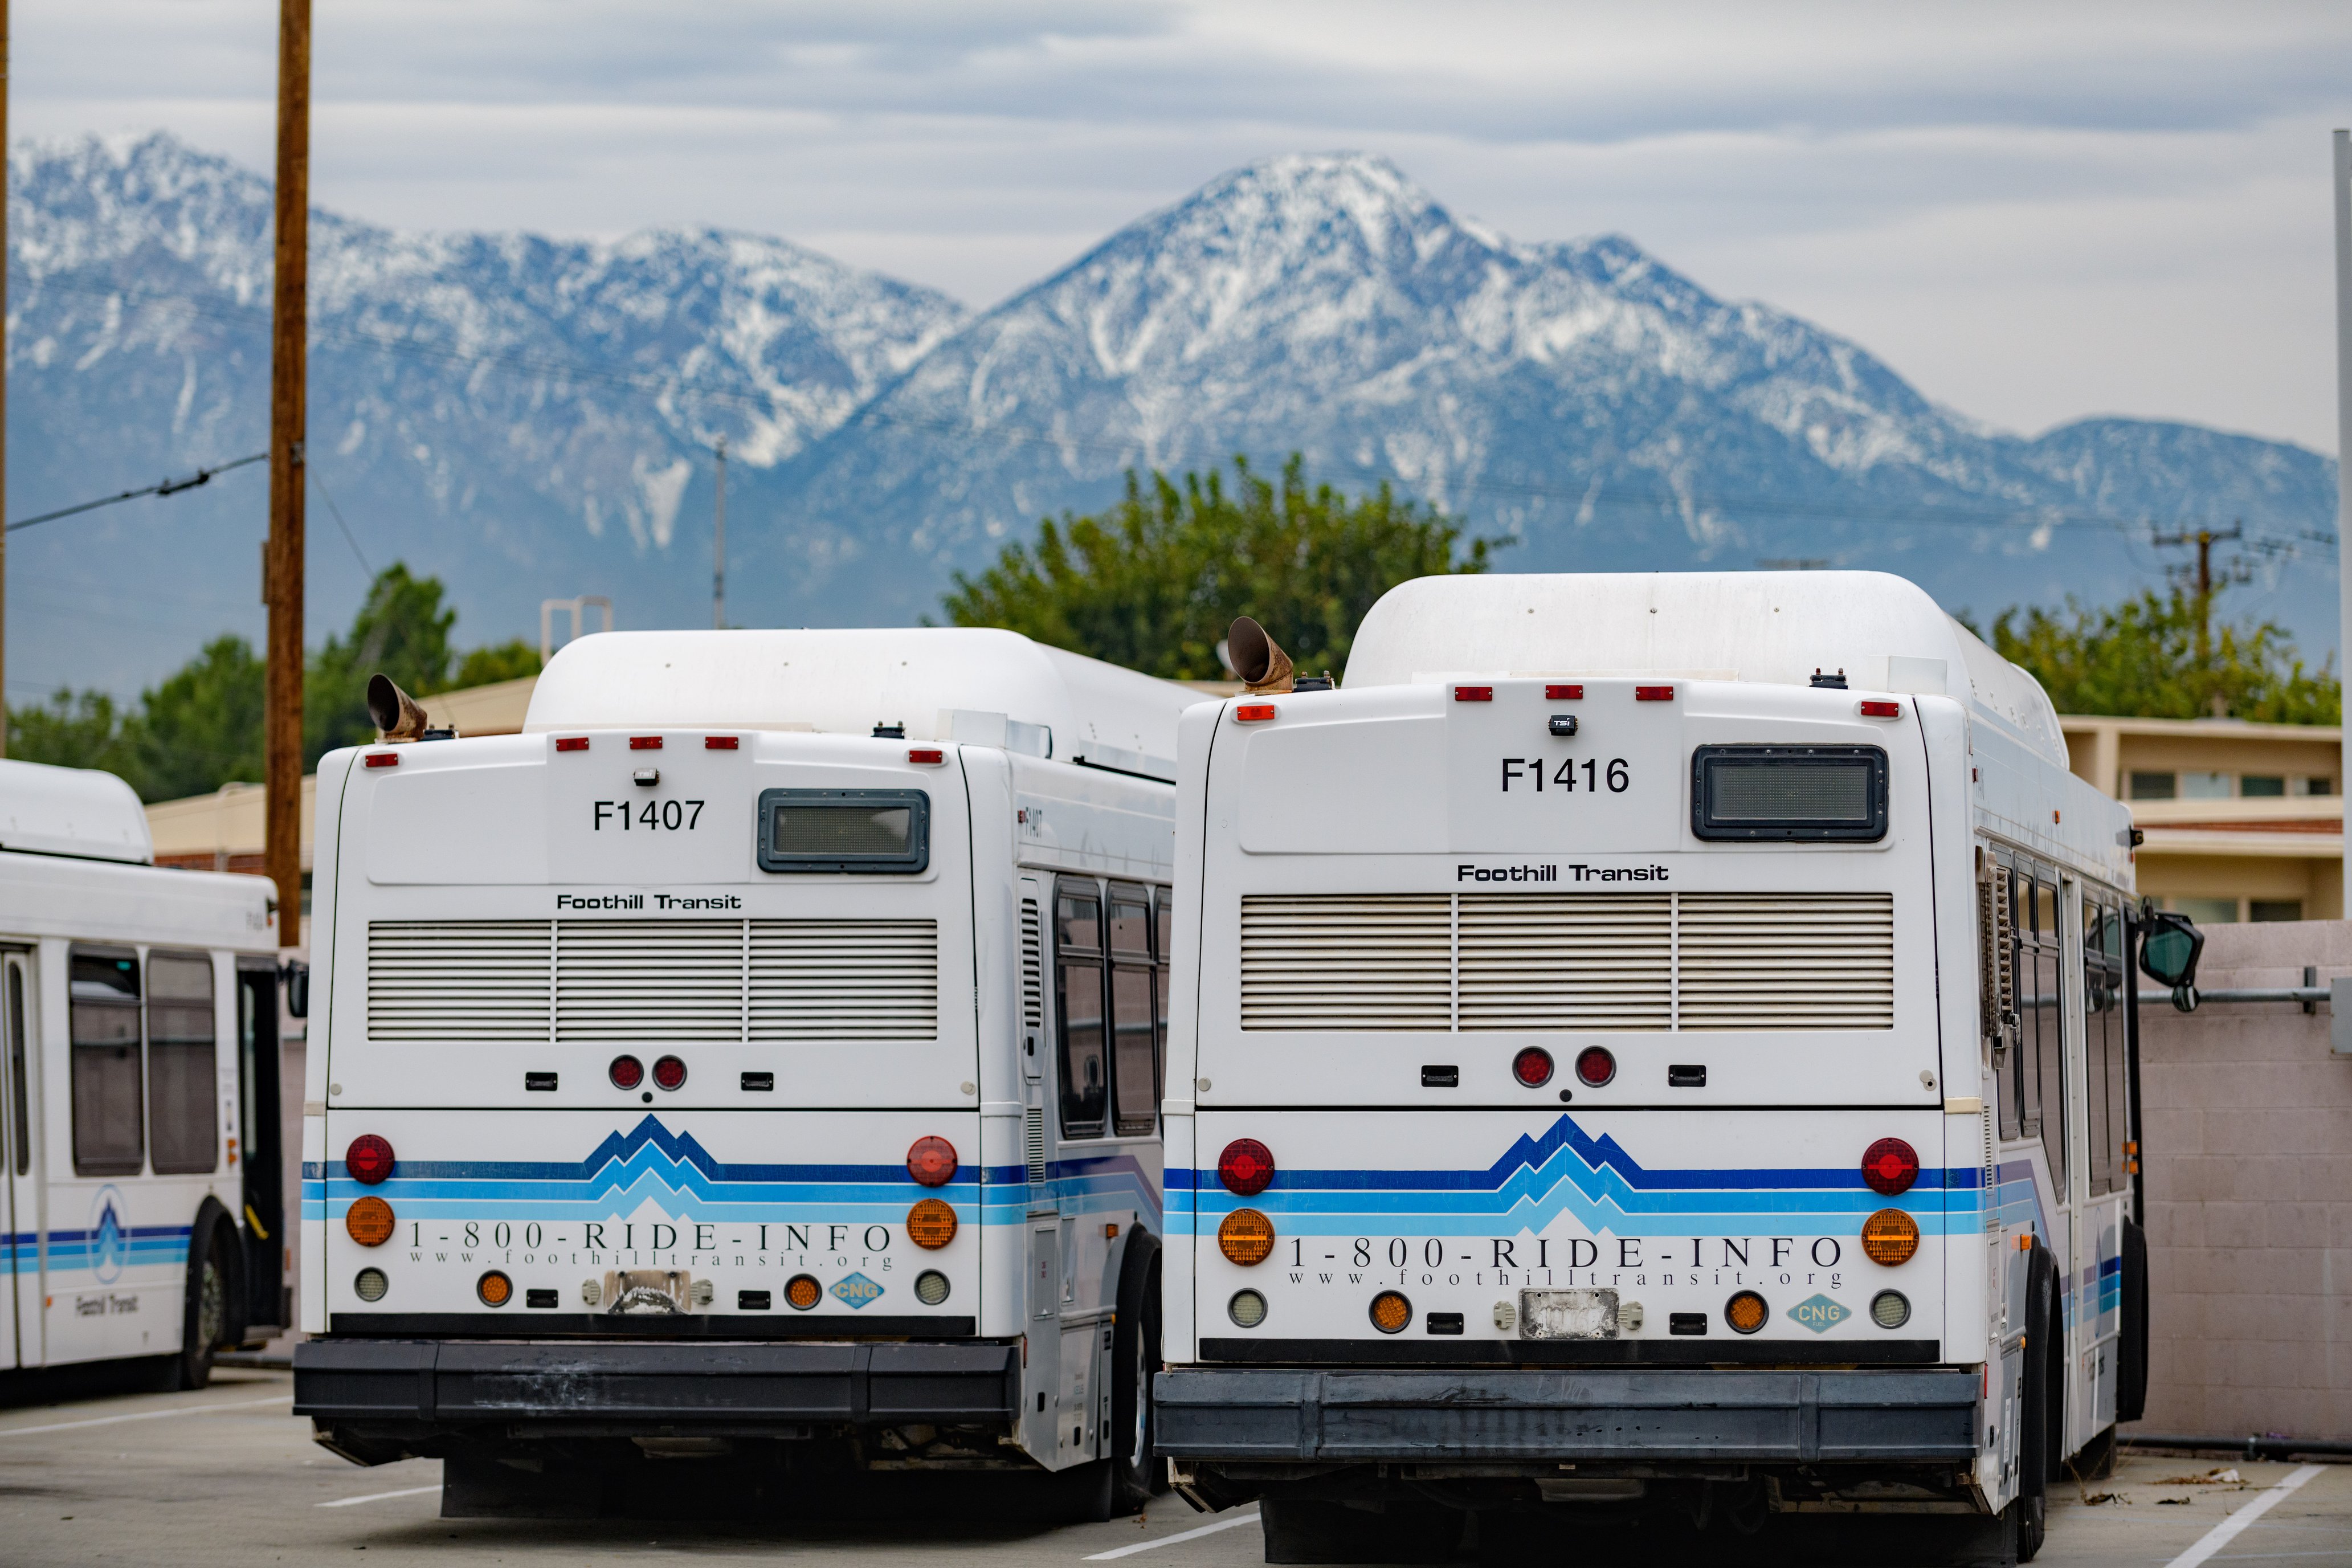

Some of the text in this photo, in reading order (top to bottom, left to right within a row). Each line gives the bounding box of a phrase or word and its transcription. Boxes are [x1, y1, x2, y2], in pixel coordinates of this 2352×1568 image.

[1502, 758, 1630, 793] F1416
[594, 799, 705, 831] F1407
[1026, 807, 1042, 838] F1407
[1457, 864, 1669, 882] Foothill Transit
[557, 894, 742, 909] Foothill Transit
[410, 1221, 890, 1252] 1-800-RIDE-INFO
[410, 1250, 892, 1271] www.foothilltransit.org
[1291, 1237, 1841, 1268] 1-800-RIDE-INFO
[1289, 1268, 1841, 1289] www.foothilltransit.org
[836, 1283, 877, 1297] CNG
[1799, 1305, 1840, 1321] CNG
